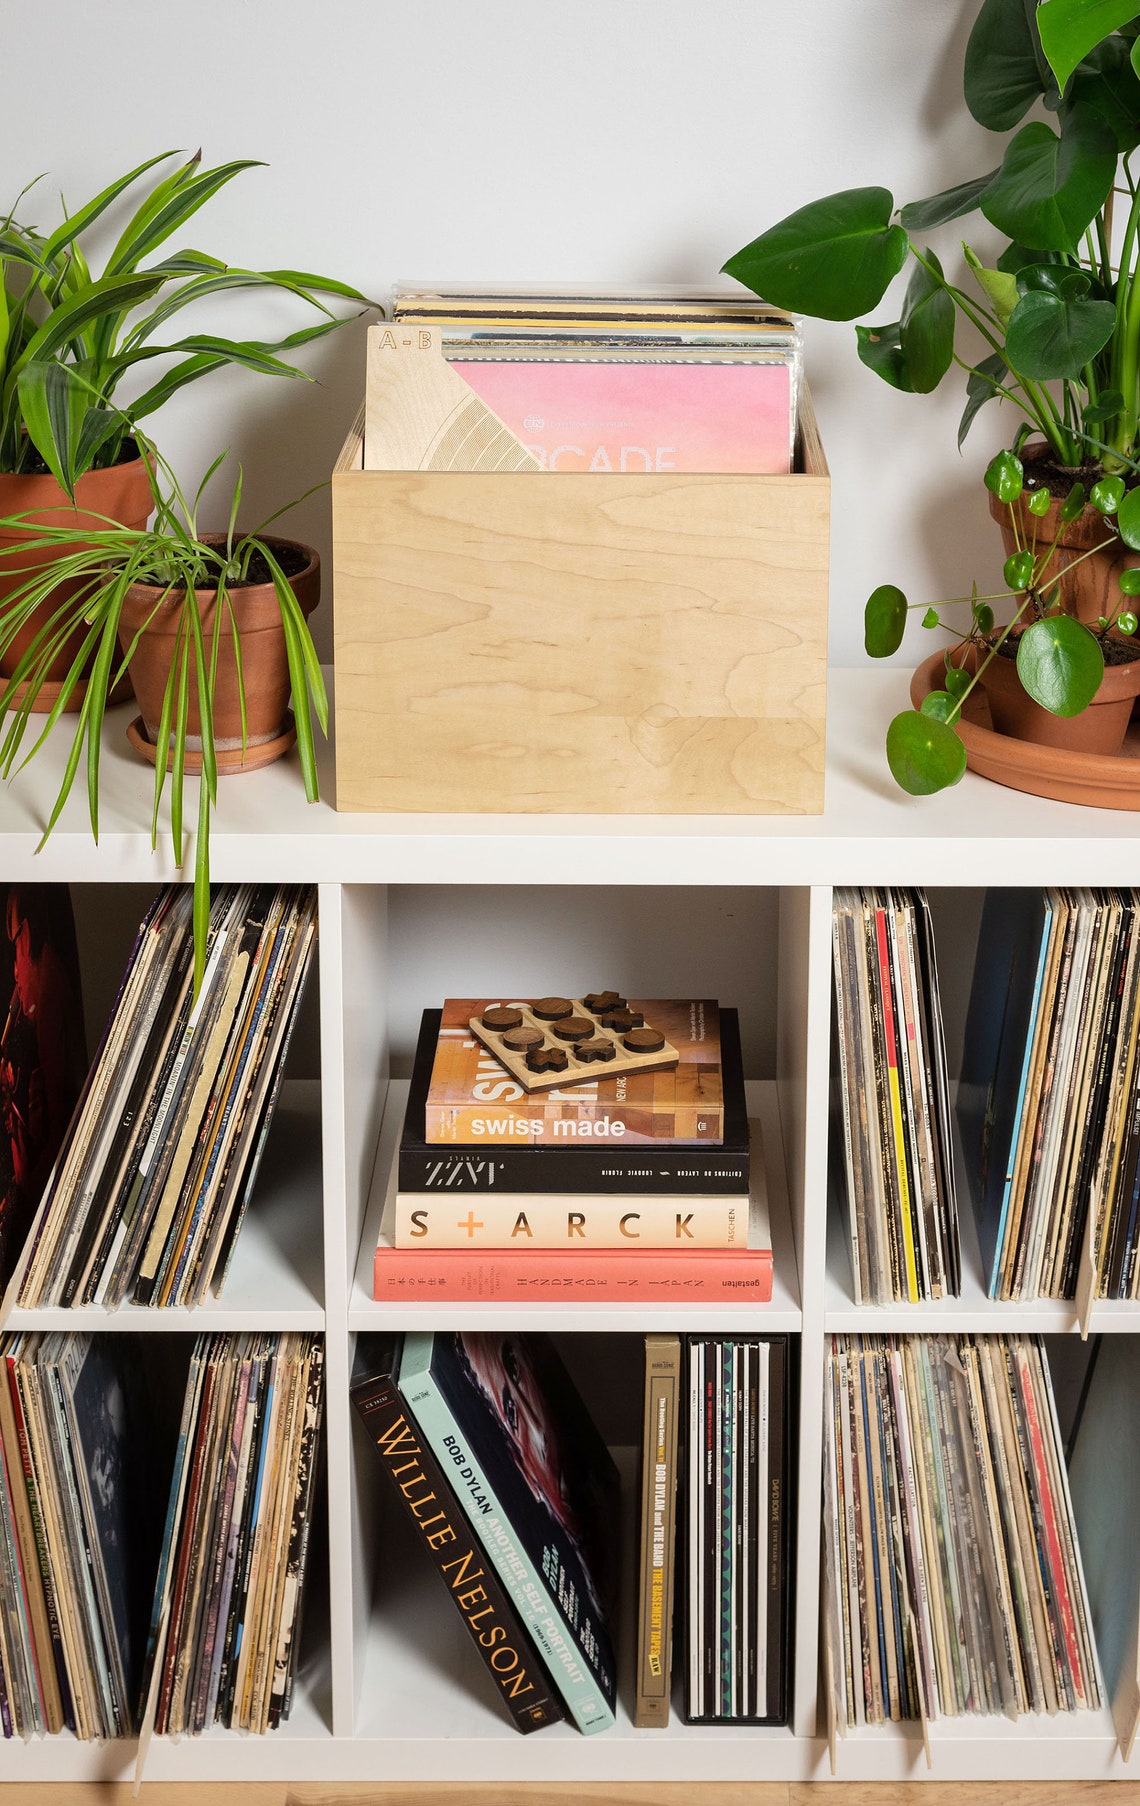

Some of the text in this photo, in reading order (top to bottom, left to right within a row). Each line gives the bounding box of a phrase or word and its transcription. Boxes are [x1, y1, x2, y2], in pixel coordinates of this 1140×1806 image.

[379, 331, 396, 349] A
[419, 331, 431, 349] B
[525, 444, 677, 472] CADE
[167, 1060, 182, 1087] MOANIN'
[161, 1095, 170, 1107] THE
[165, 1087, 173, 1095] IN
[614, 1088, 627, 1103] NEW
[149, 1108, 166, 1144] MOONLIGHT
[471, 1115, 626, 1137] swiss made
[728, 1208, 736, 1243] TASCHEN
[517, 1278, 608, 1286] HANDMADE
[722, 1280, 760, 1288] gestalten
[283, 1375, 297, 1441] THE ROLLING STONES
[18, 1427, 27, 1445] TOM
[21, 1447, 32, 1474] PETTY
[653, 1464, 666, 1481] BOB
[27, 1484, 37, 1505] THE
[653, 1483, 666, 1510] DYLAN
[652, 1512, 665, 1525] and
[31, 1508, 49, 1576] HEARTBREAKERS
[652, 1526, 664, 1542] THE
[374, 1413, 538, 1703] WILLIE NELSON
[441, 1433, 586, 1686] BOB DYLAN ANOTHER SELF PORTRAIT
[464, 1498, 478, 1516] THE
[474, 1516, 499, 1554] BOOTLEG
[495, 1554, 517, 1587] SERIES
[512, 1586, 529, 1609] VOL.
[524, 1609, 535, 1622] 10
[652, 1544, 664, 1567] BAND
[651, 1568, 664, 1583] THE
[43, 1578, 56, 1621] HYPNOTIC
[650, 1584, 664, 1629] BASEMENT
[50, 1623, 59, 1640] EYE
[650, 1630, 663, 1655] TAPES
[650, 1656, 660, 1674] RAW
